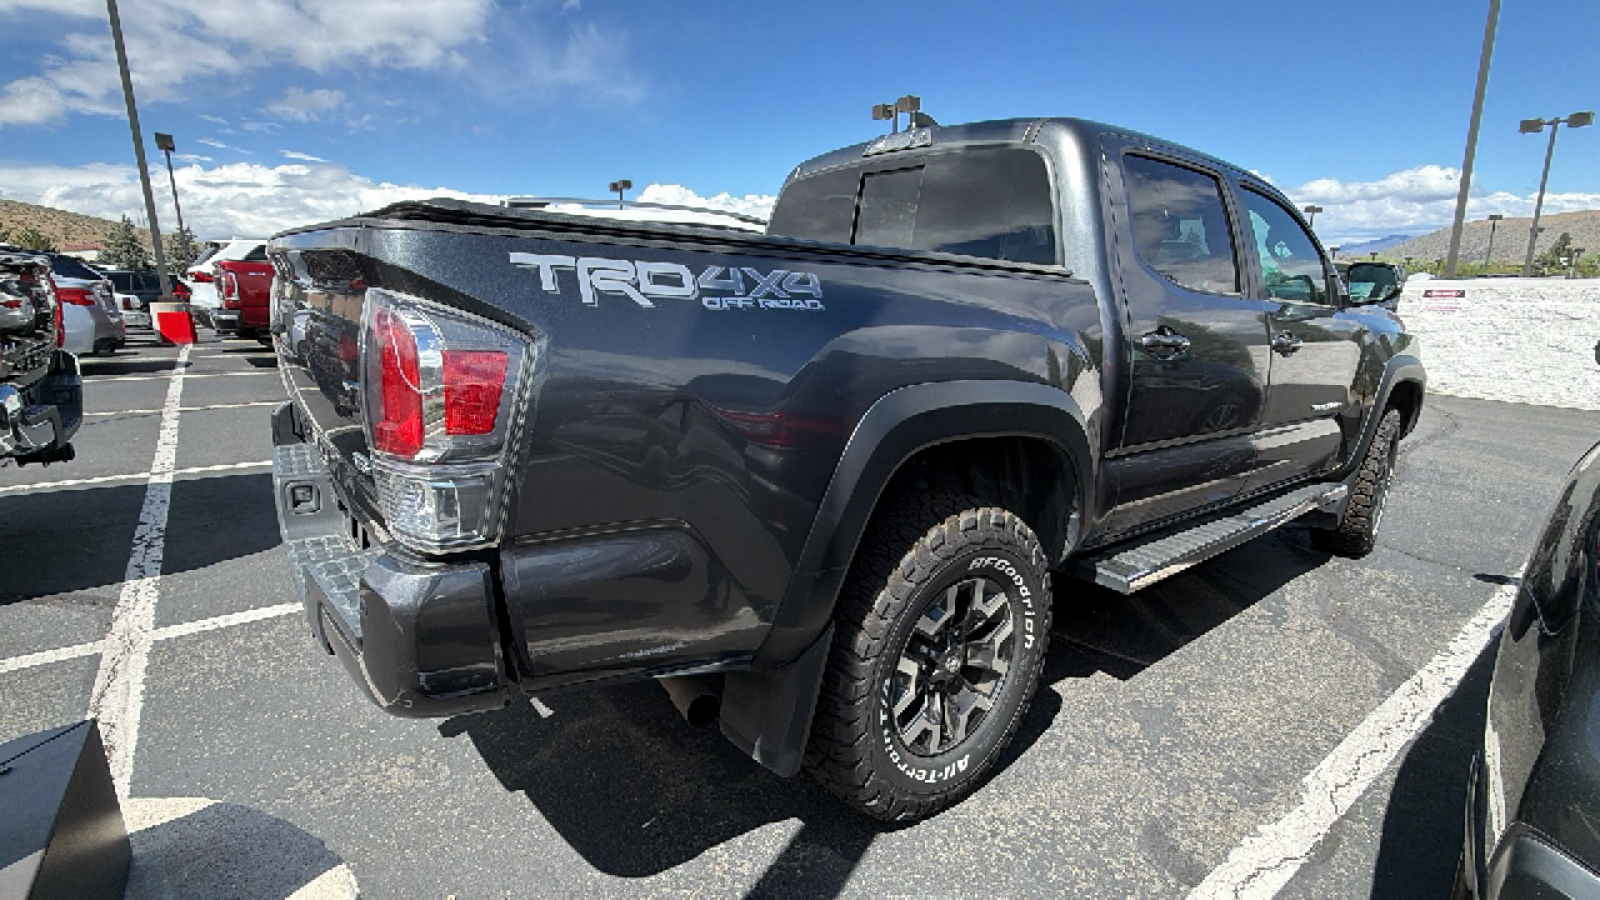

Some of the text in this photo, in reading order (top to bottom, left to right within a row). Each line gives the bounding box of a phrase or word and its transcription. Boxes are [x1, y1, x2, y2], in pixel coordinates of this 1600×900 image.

[509, 252, 698, 307] TRD
[702, 296, 825, 310] OFF ROAD
[967, 557, 1035, 649] BFGoodrich
